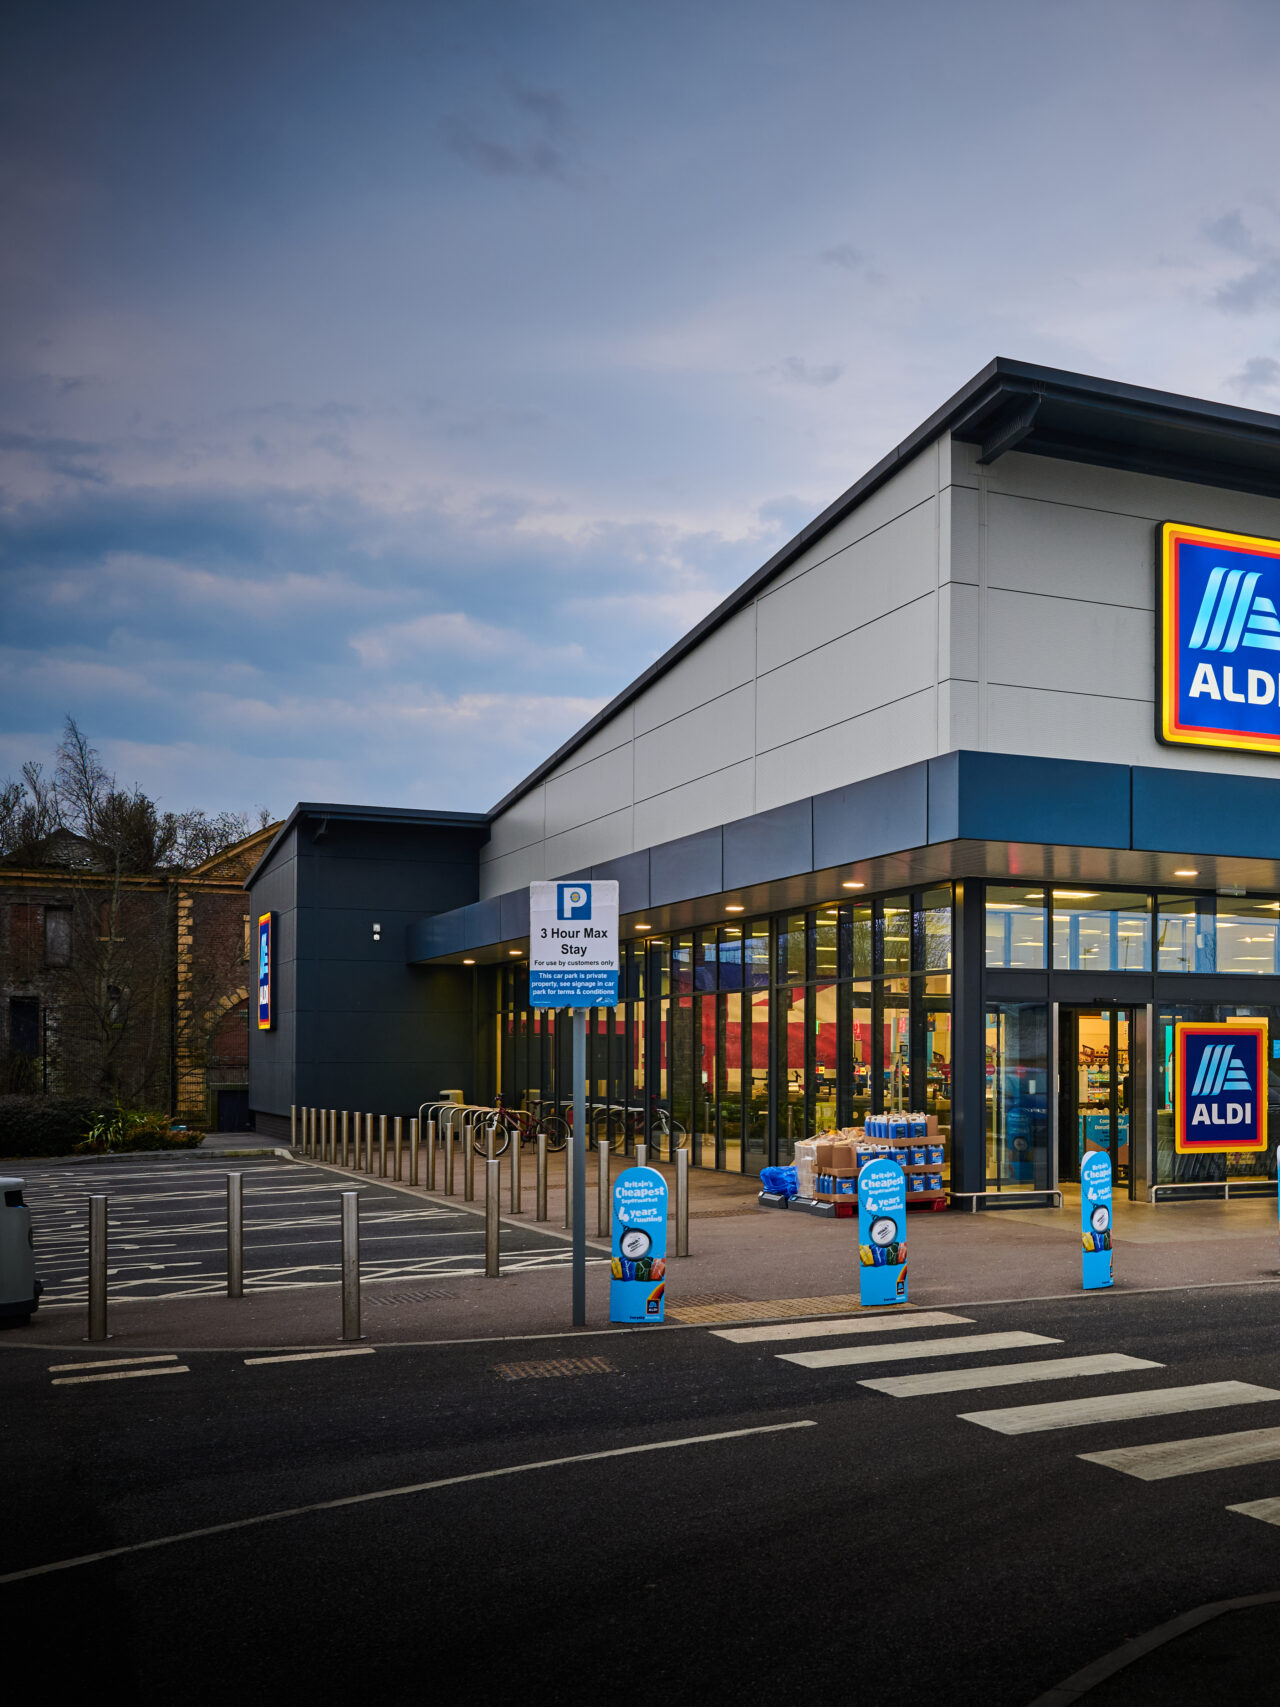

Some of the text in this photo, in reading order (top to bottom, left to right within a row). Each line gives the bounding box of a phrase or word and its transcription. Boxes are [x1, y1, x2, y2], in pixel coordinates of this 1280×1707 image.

[563, 887, 587, 918] P
[541, 928, 608, 939] 3 Hour Max
[561, 944, 587, 957] Stay
[1191, 1103, 1252, 1125] ALDI
[871, 1171, 896, 1179] Britain's
[624, 1180, 653, 1188] Britain's
[861, 1176, 904, 1190] Cheapest
[615, 1187, 664, 1198] Cheapest
[1088, 1187, 1098, 1201] 4
[866, 1196, 900, 1212] 4 years
[618, 1206, 657, 1222] 4 years
